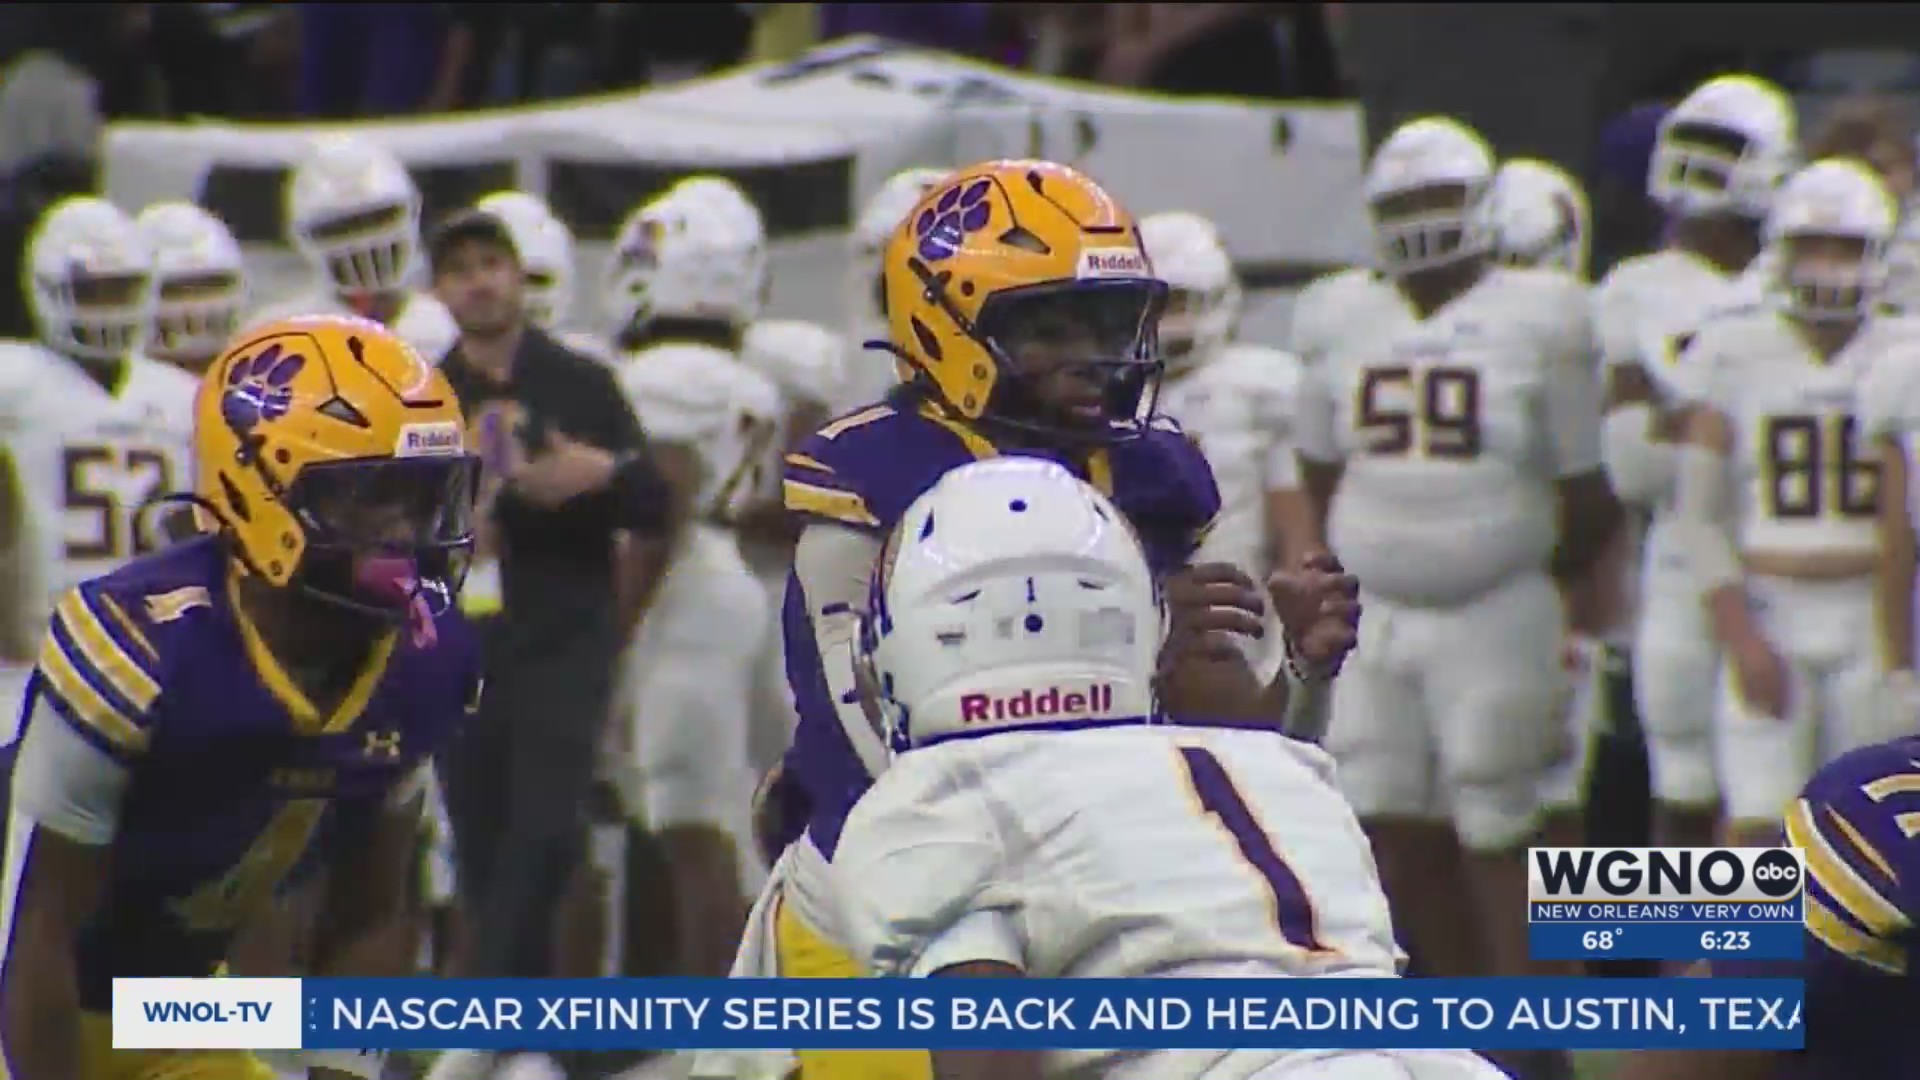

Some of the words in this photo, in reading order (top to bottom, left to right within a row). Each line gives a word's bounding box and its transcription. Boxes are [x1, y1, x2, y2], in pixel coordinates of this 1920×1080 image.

[1357, 365, 1481, 457] 59
[959, 684, 1113, 723] Riddell
[1175, 744, 1340, 955] 1
